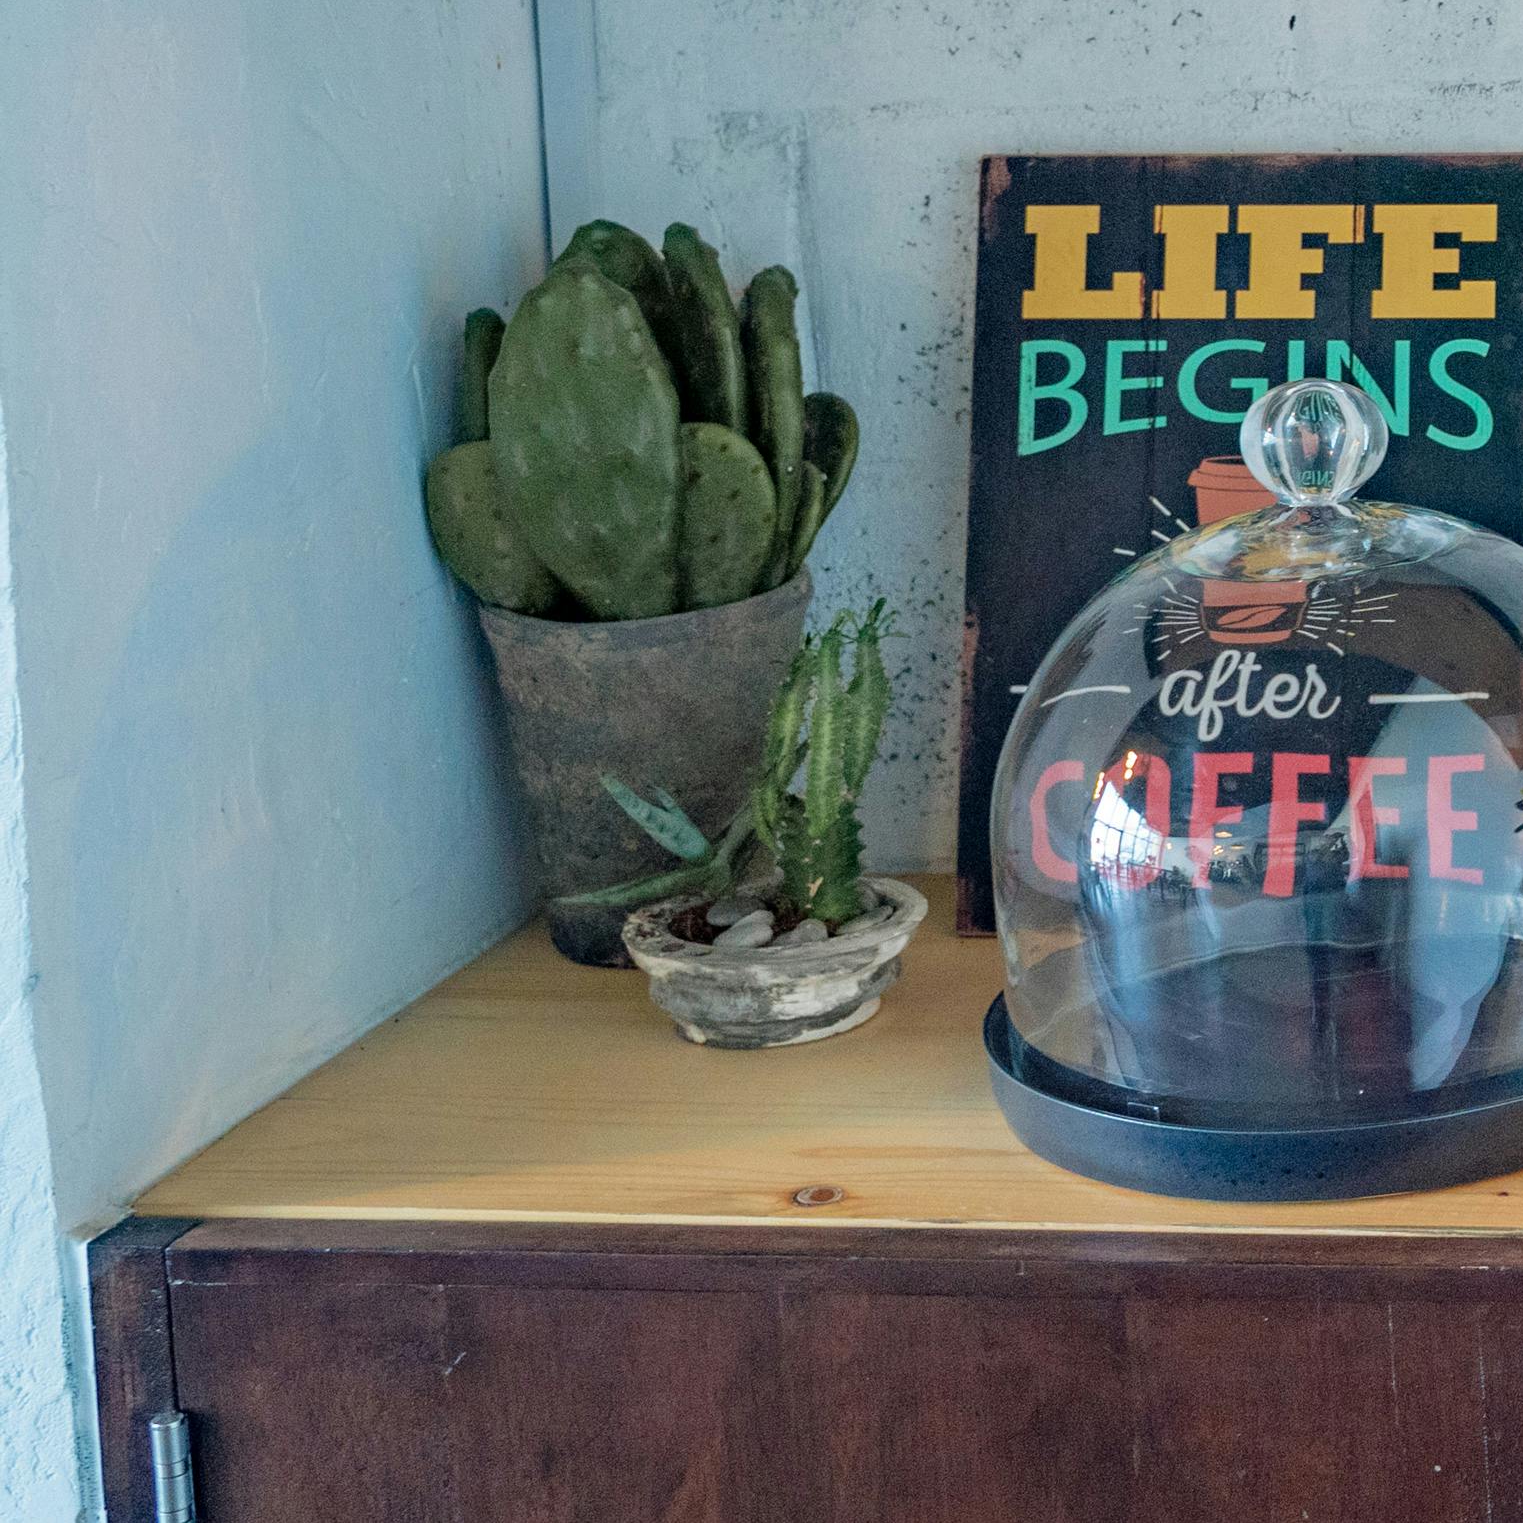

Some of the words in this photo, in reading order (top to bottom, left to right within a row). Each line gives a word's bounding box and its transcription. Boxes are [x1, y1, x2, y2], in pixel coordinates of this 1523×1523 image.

[1022, 204, 1497, 319] LIFE
[1158, 649, 1340, 742] after
[1030, 752, 1486, 898] COFFEE
